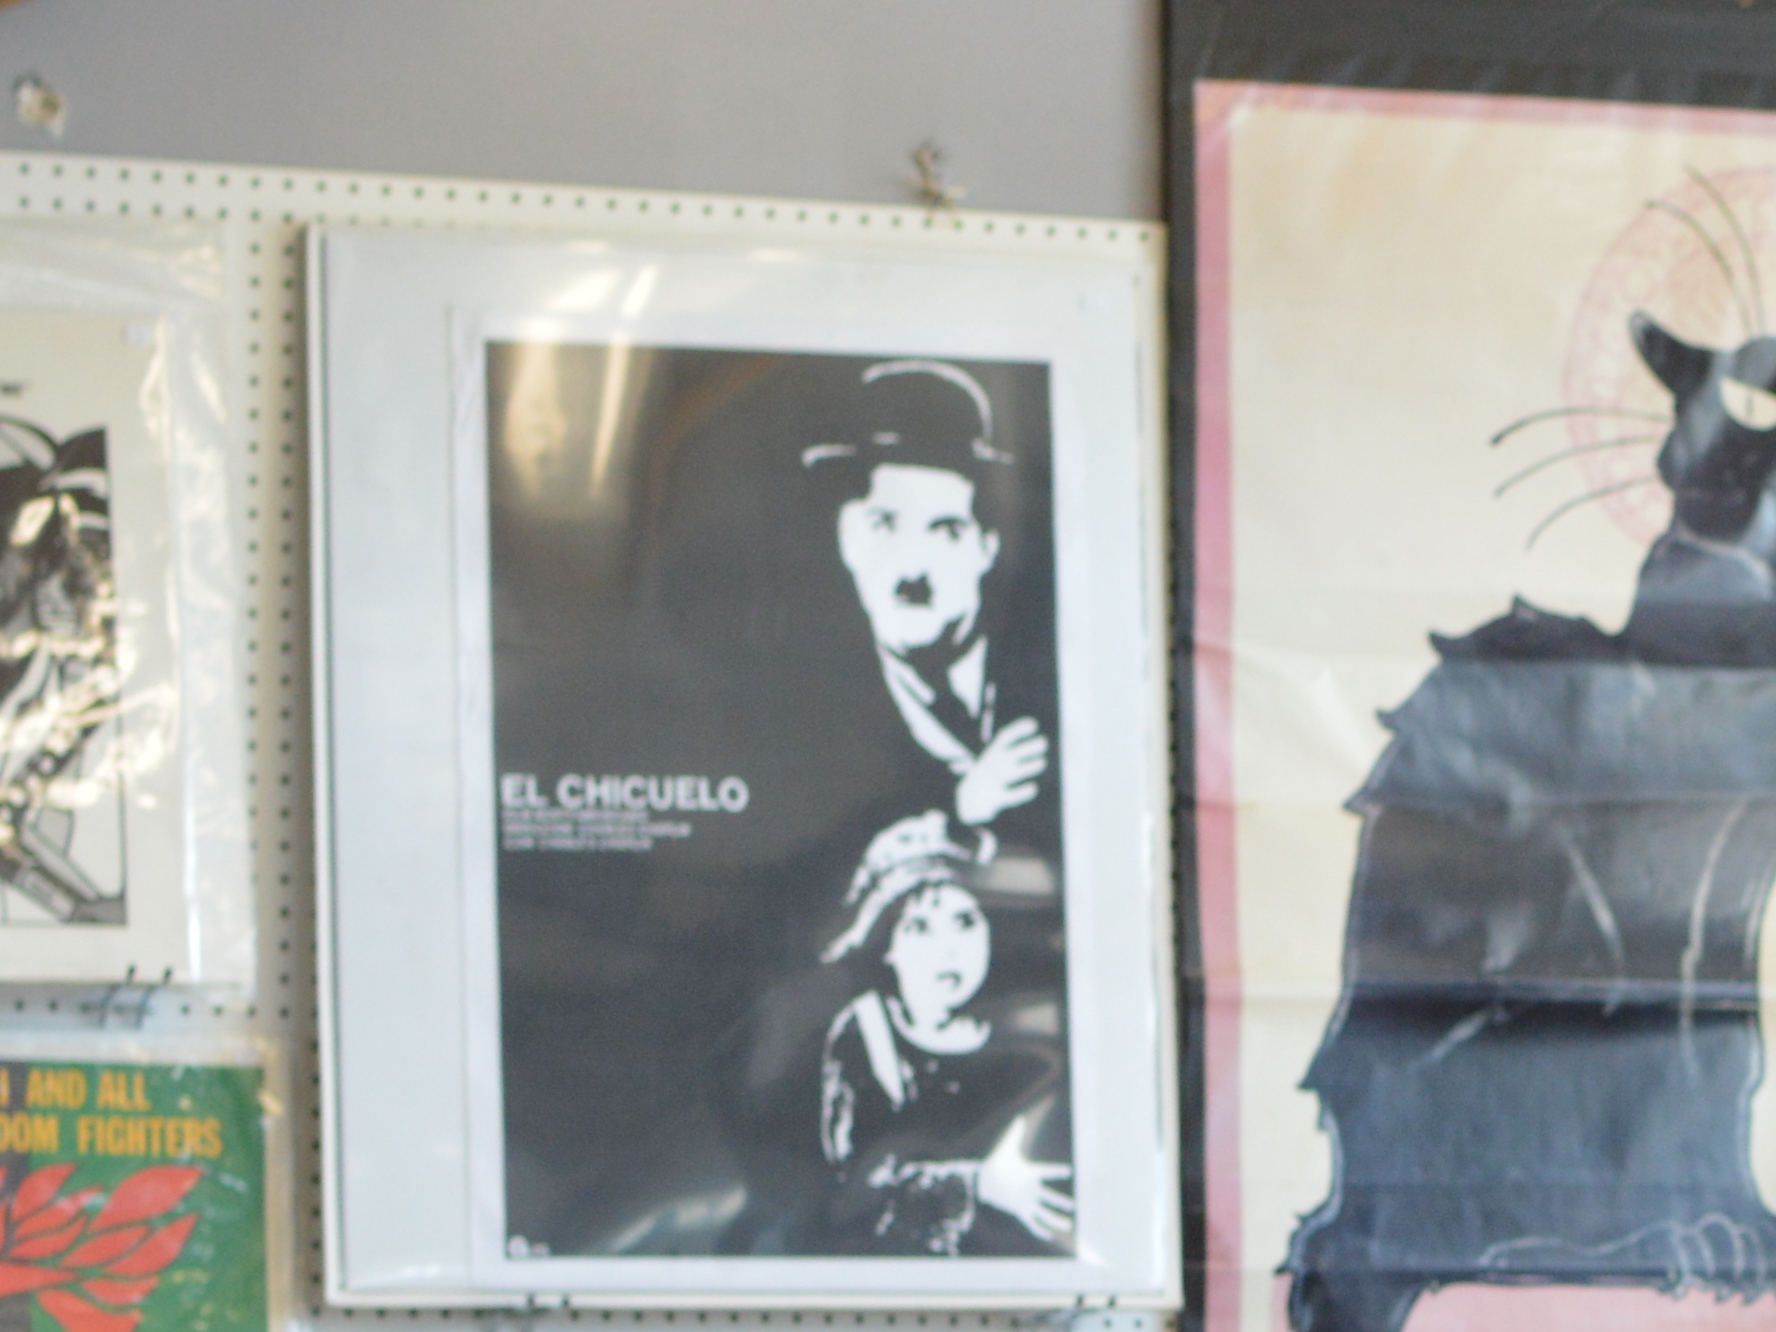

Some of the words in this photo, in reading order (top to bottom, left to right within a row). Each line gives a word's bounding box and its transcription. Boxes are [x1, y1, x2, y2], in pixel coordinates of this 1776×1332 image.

[501, 773, 549, 809] EL
[556, 773, 749, 812] CHICUELO
[27, 1069, 88, 1109] AND
[97, 1071, 152, 1111] ALL
[77, 1114, 223, 1158] FIGHTERS
